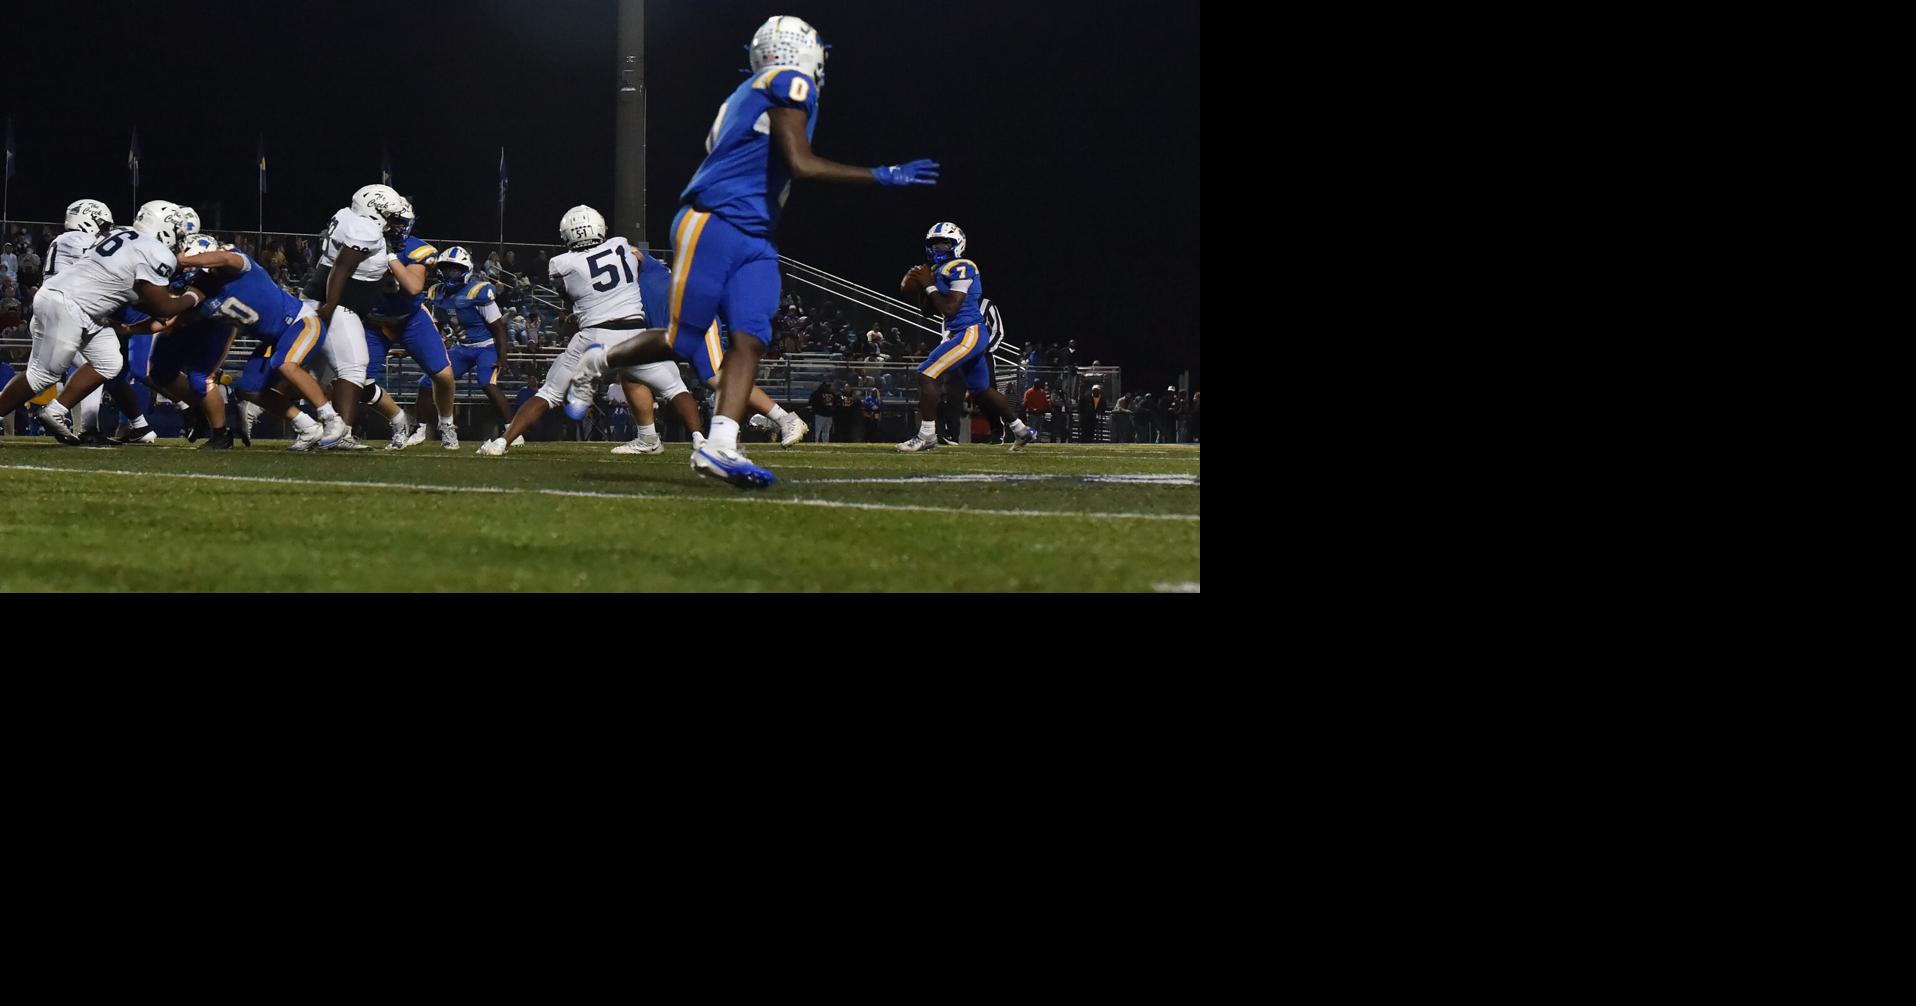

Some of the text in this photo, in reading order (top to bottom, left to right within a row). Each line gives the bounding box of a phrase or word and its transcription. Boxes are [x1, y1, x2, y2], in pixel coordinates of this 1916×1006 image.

[788, 76, 809, 102] 0
[366, 199, 390, 210] Creek
[586, 245, 634, 293] 51
[955, 265, 967, 279] 7
